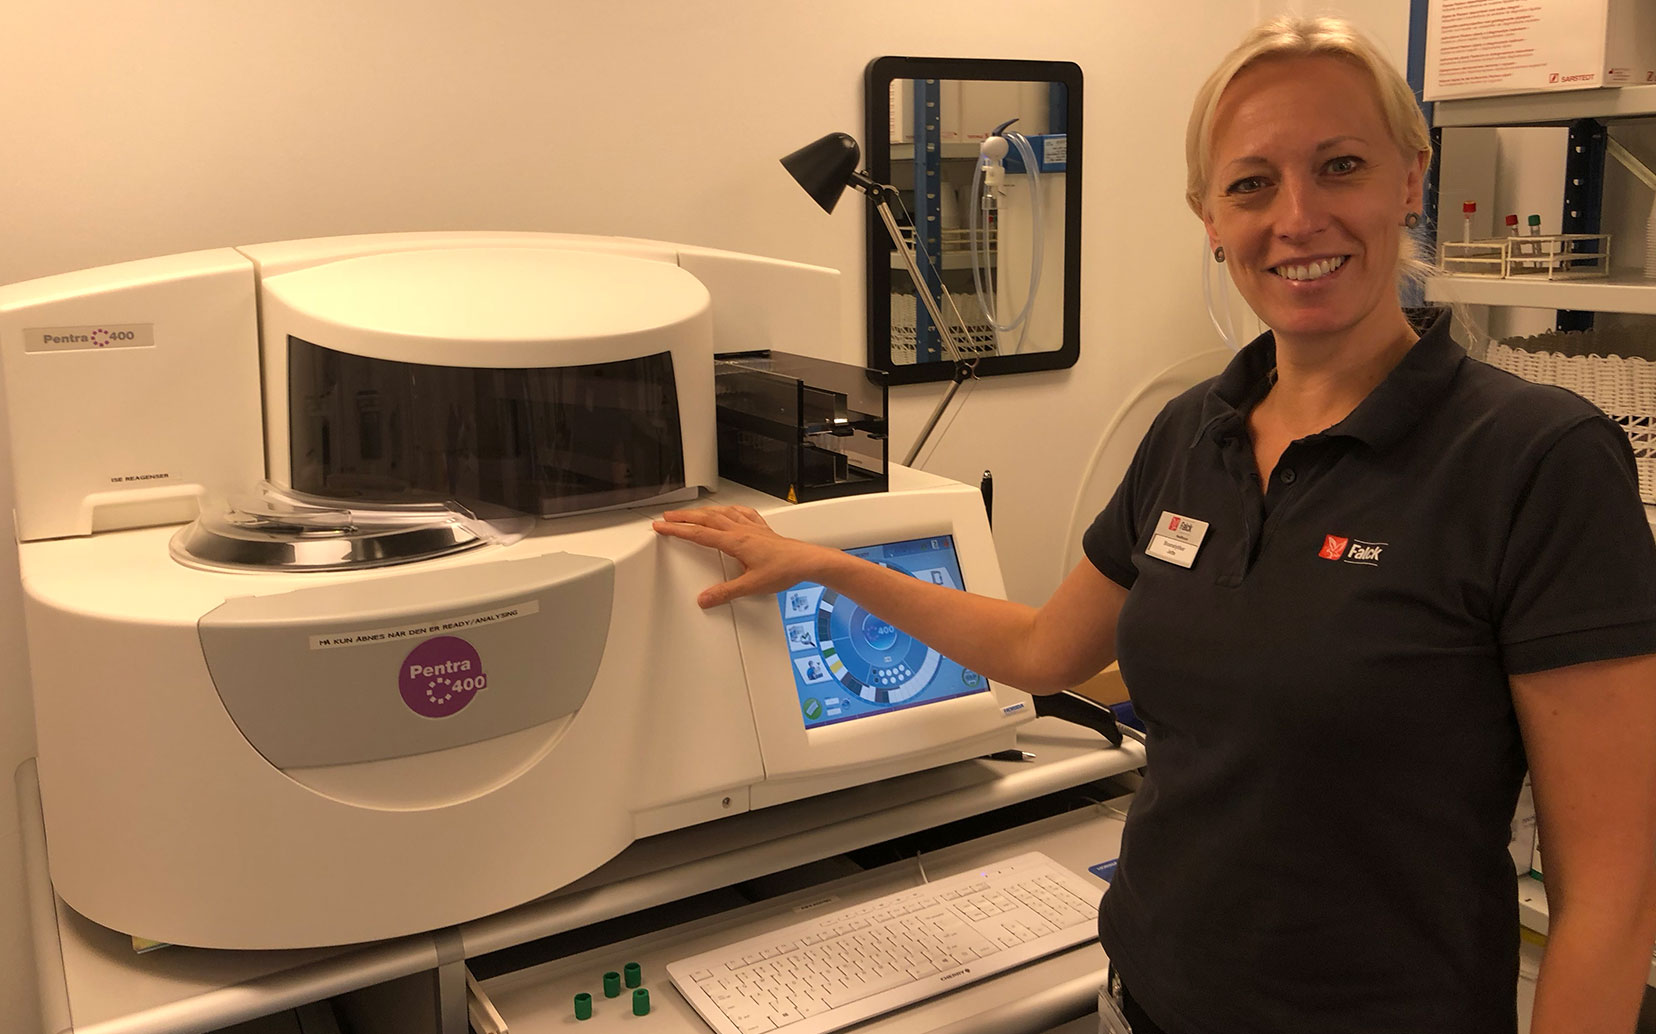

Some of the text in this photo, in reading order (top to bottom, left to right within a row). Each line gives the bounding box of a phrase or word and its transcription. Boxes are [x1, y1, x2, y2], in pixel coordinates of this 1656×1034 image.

[1560, 73, 1596, 83] SARSTEDT
[43, 333, 89, 345] Pentra
[125, 473, 169, 481] REAGENSER
[1347, 543, 1383, 561] Falck
[333, 636, 353, 645] KUN
[408, 626, 427, 636] DEN
[429, 625, 440, 633] ER
[409, 659, 472, 679] Pentra
